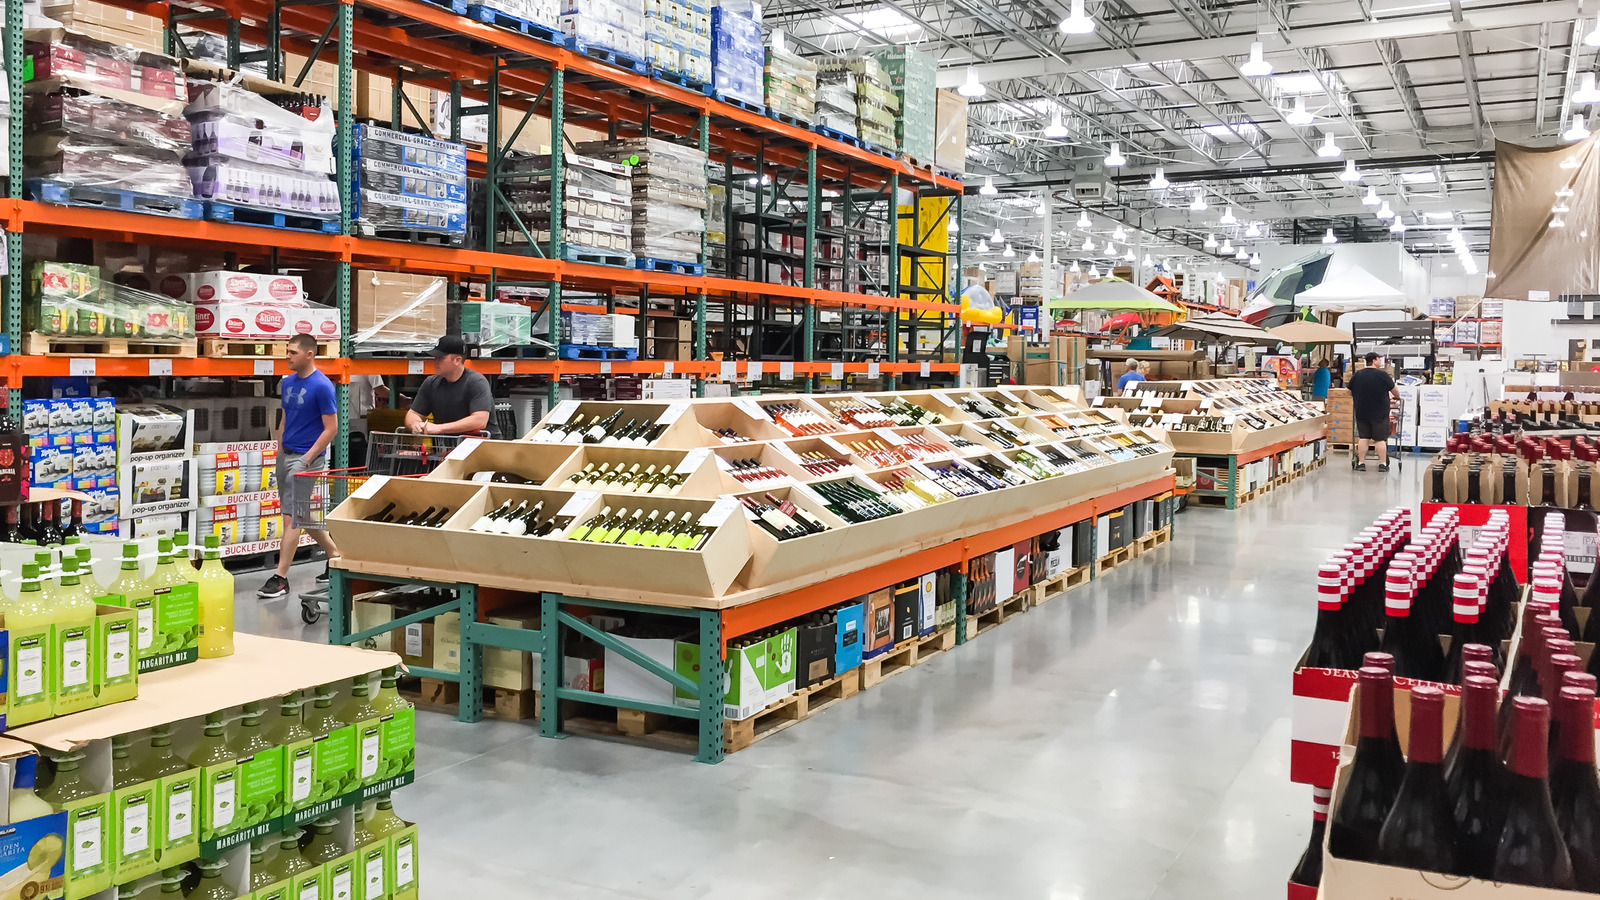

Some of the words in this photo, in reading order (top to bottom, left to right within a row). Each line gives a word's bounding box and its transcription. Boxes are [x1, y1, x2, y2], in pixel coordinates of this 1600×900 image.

[374, 129, 431, 146] COMMERCIAL-GRADE
[146, 312, 169, 327] XX
[259, 313, 281, 322] Shiner
[226, 443, 258, 452] BUCKLE
[260, 442, 271, 450] UP
[129, 454, 153, 463] pop-up
[154, 451, 185, 461] organizer
[227, 493, 258, 504] BUCKLE
[260, 492, 271, 500] UP
[131, 505, 156, 515] pop-up
[157, 501, 190, 511] organizer
[225, 543, 257, 555] BUCKLE
[258, 543, 269, 551] UP
[138, 655, 174, 670] MARGARITA
[175, 651, 188, 662] MIX
[1322, 667, 1360, 680] SEAS
[363, 781, 394, 798] MARGARITA
[395, 776, 405, 786] MIX
[294, 803, 329, 822] MARGARITA
[331, 798, 342, 809] MIX
[216, 829, 256, 850] MARGARITA
[257, 823, 270, 835] MIX
